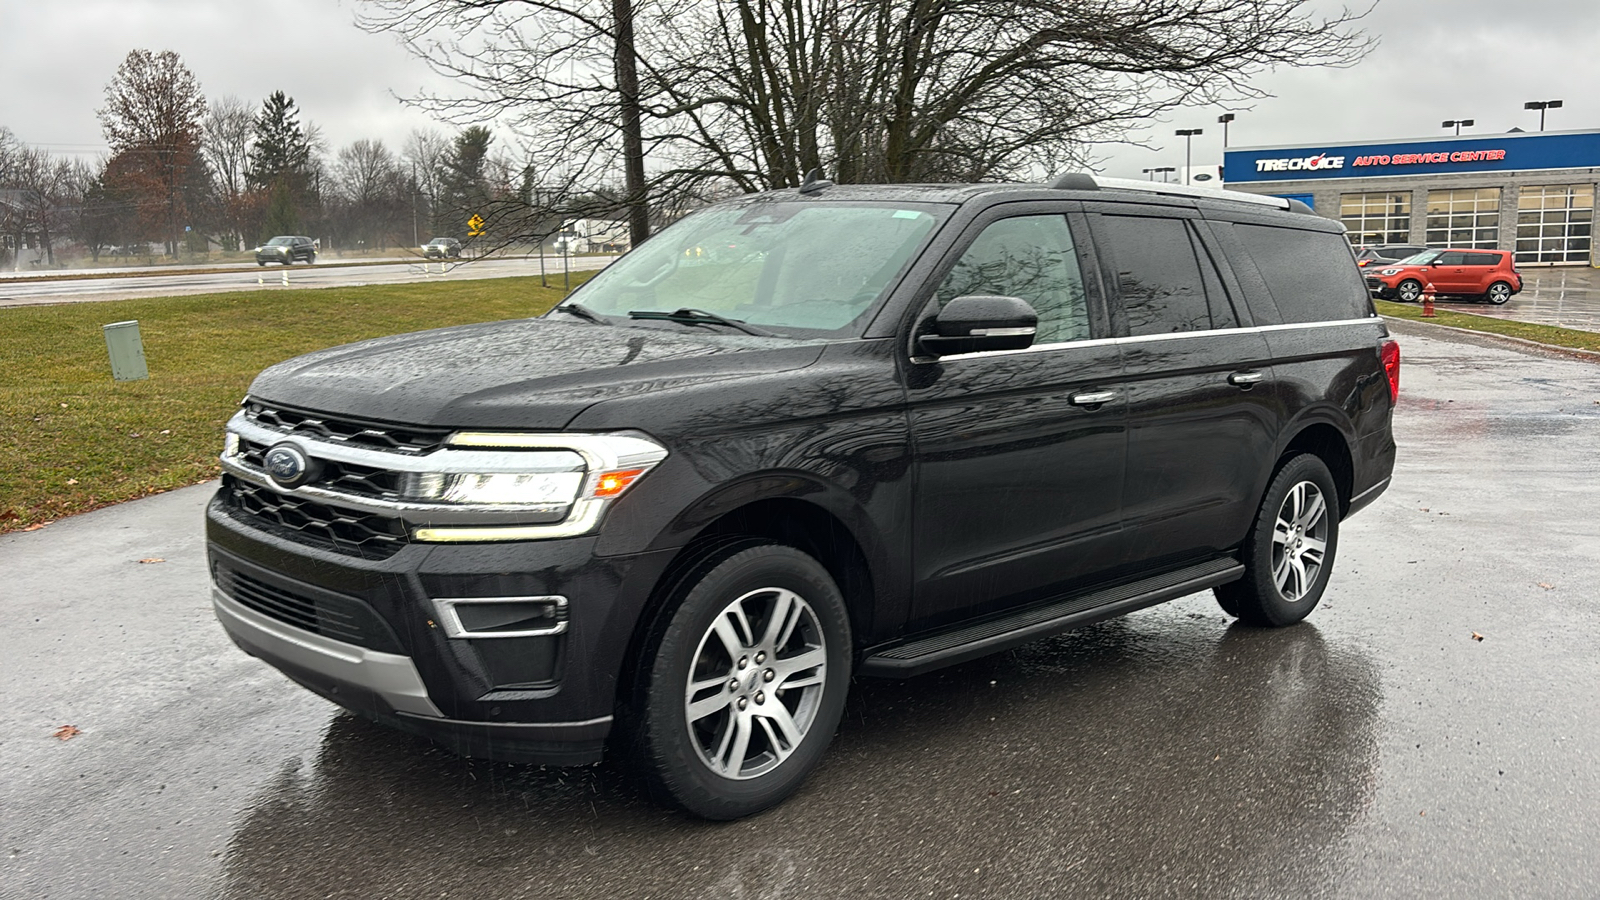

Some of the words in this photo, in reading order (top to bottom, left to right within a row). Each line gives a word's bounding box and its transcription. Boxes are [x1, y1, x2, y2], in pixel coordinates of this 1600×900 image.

[1352, 155, 1391, 167] AUTO
[1391, 152, 1449, 165] SERVICE
[1450, 149, 1506, 162] CENTER
